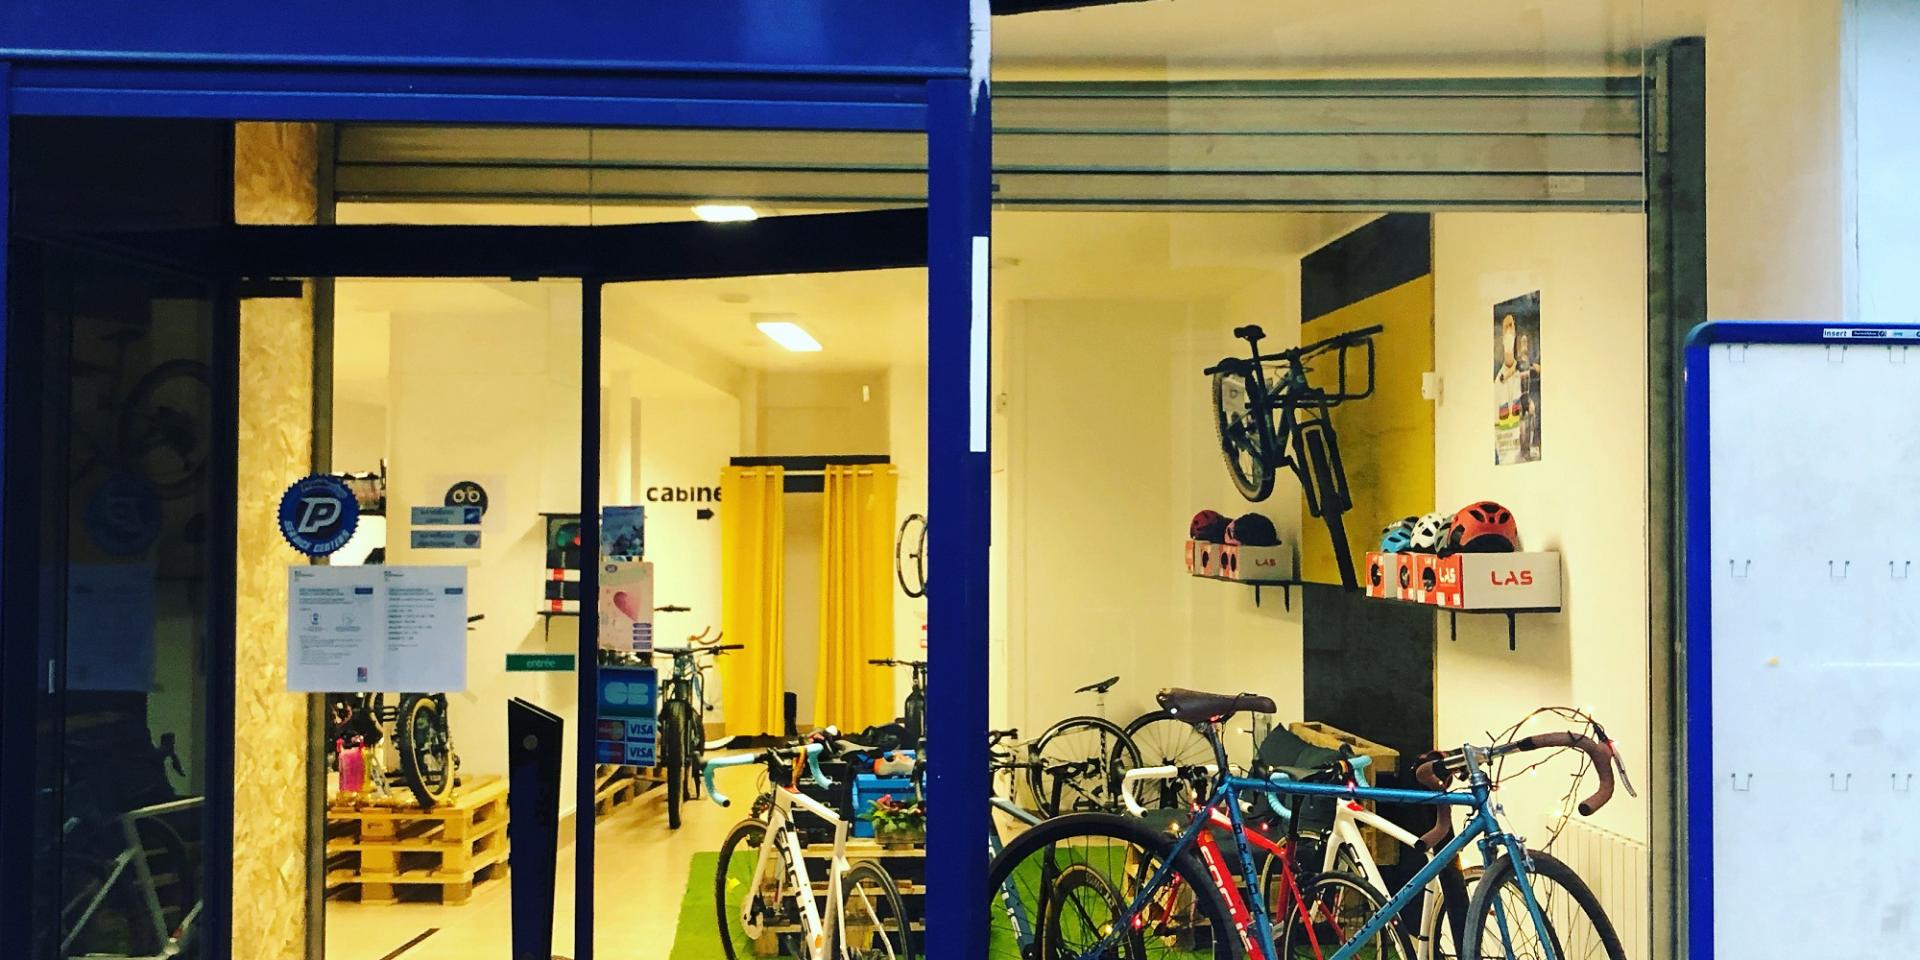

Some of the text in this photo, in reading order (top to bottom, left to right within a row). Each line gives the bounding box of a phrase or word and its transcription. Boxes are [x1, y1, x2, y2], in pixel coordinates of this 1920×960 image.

[1824, 329, 1847, 337] Insert
[1439, 567, 1456, 583] LAS
[1490, 570, 1534, 586] LAS
[630, 724, 654, 735] VISA
[630, 747, 654, 758] VISA
